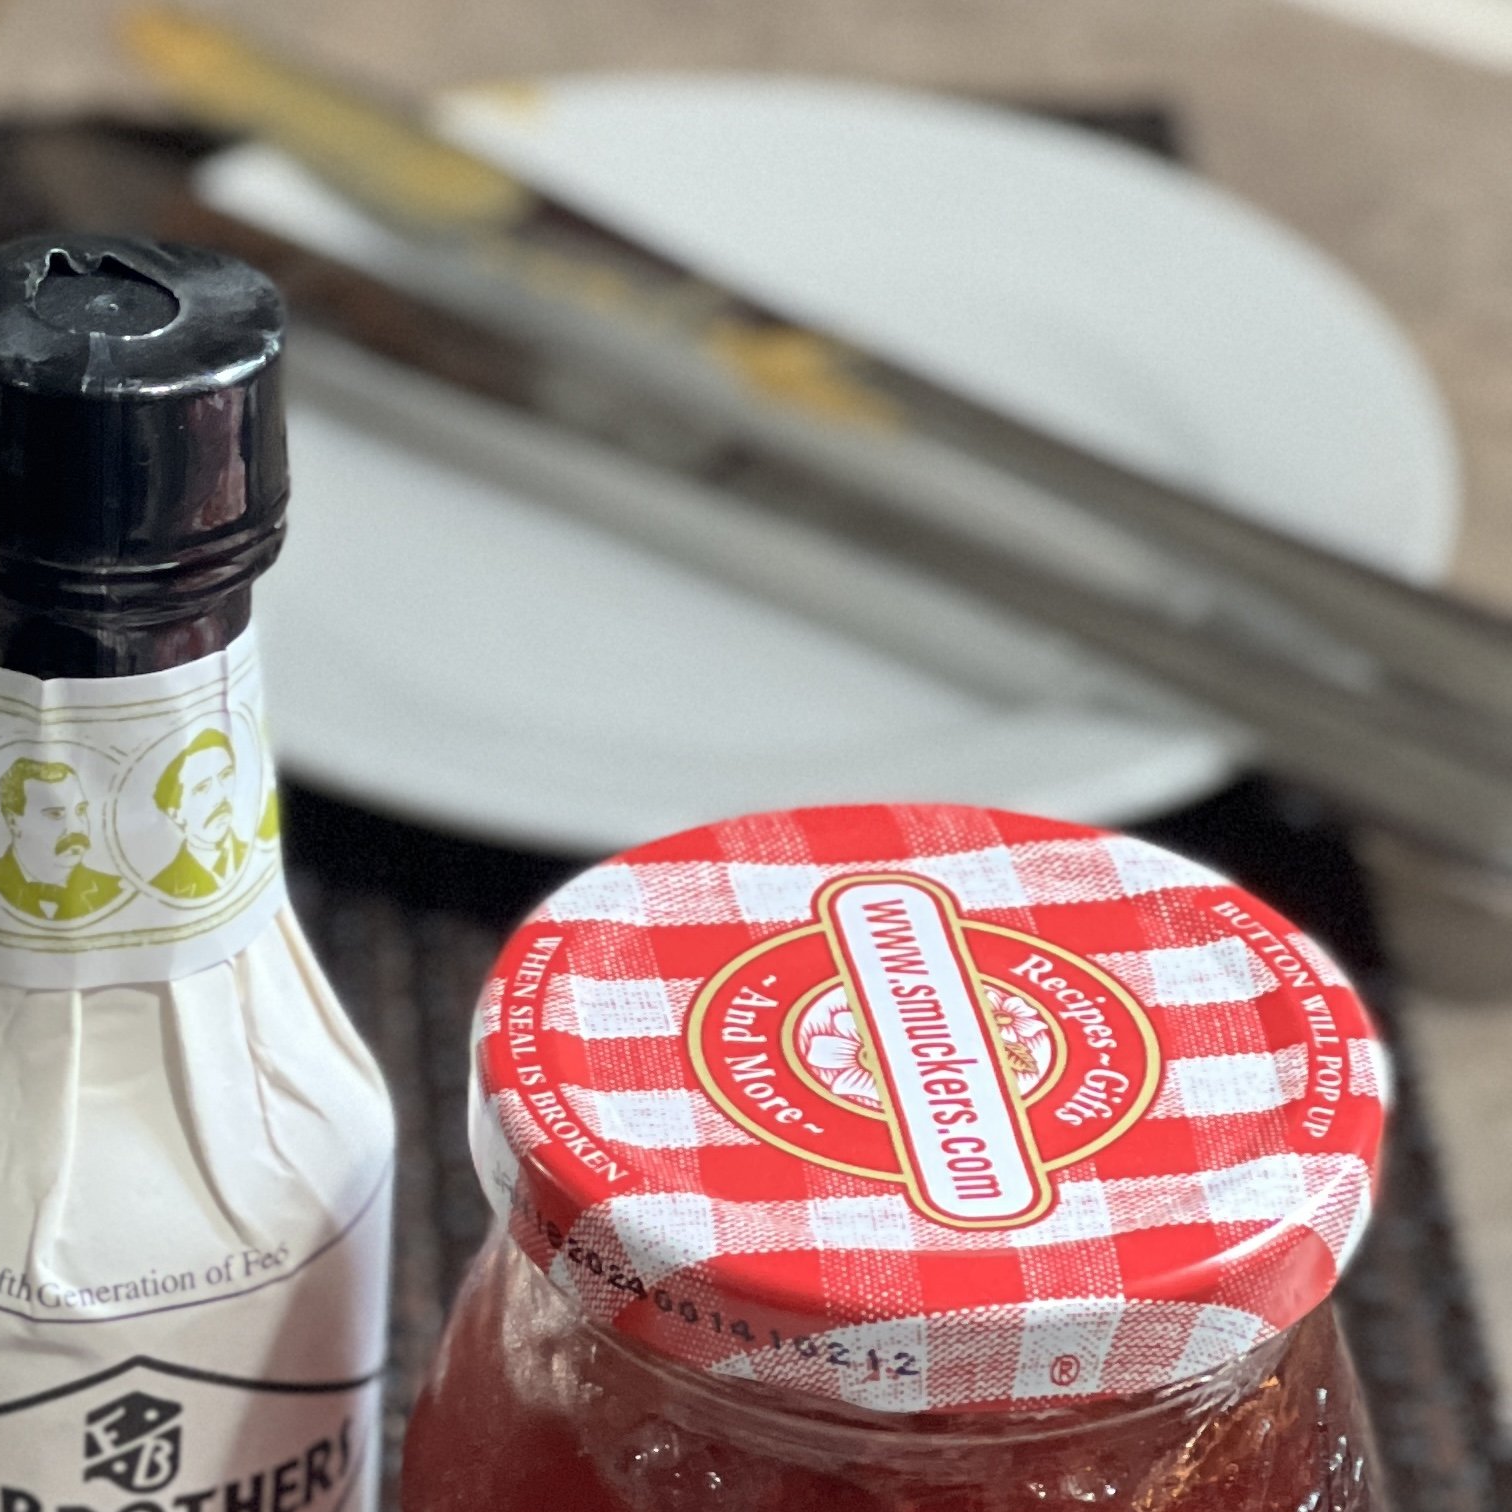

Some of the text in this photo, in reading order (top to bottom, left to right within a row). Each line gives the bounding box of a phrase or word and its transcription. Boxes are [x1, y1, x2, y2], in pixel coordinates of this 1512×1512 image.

[508, 936, 630, 1183] WHEN SEAL IS BROKEN
[721, 984, 805, 1125] And More
[862, 899, 1004, 1200] www.smuckers.com
[1010, 953, 1130, 1127] Recipes Gifts
[1211, 901, 1343, 1138] BUTTON WILL POP UP
[37, 1268, 196, 1309] Generation
[205, 1261, 234, 1286] of
